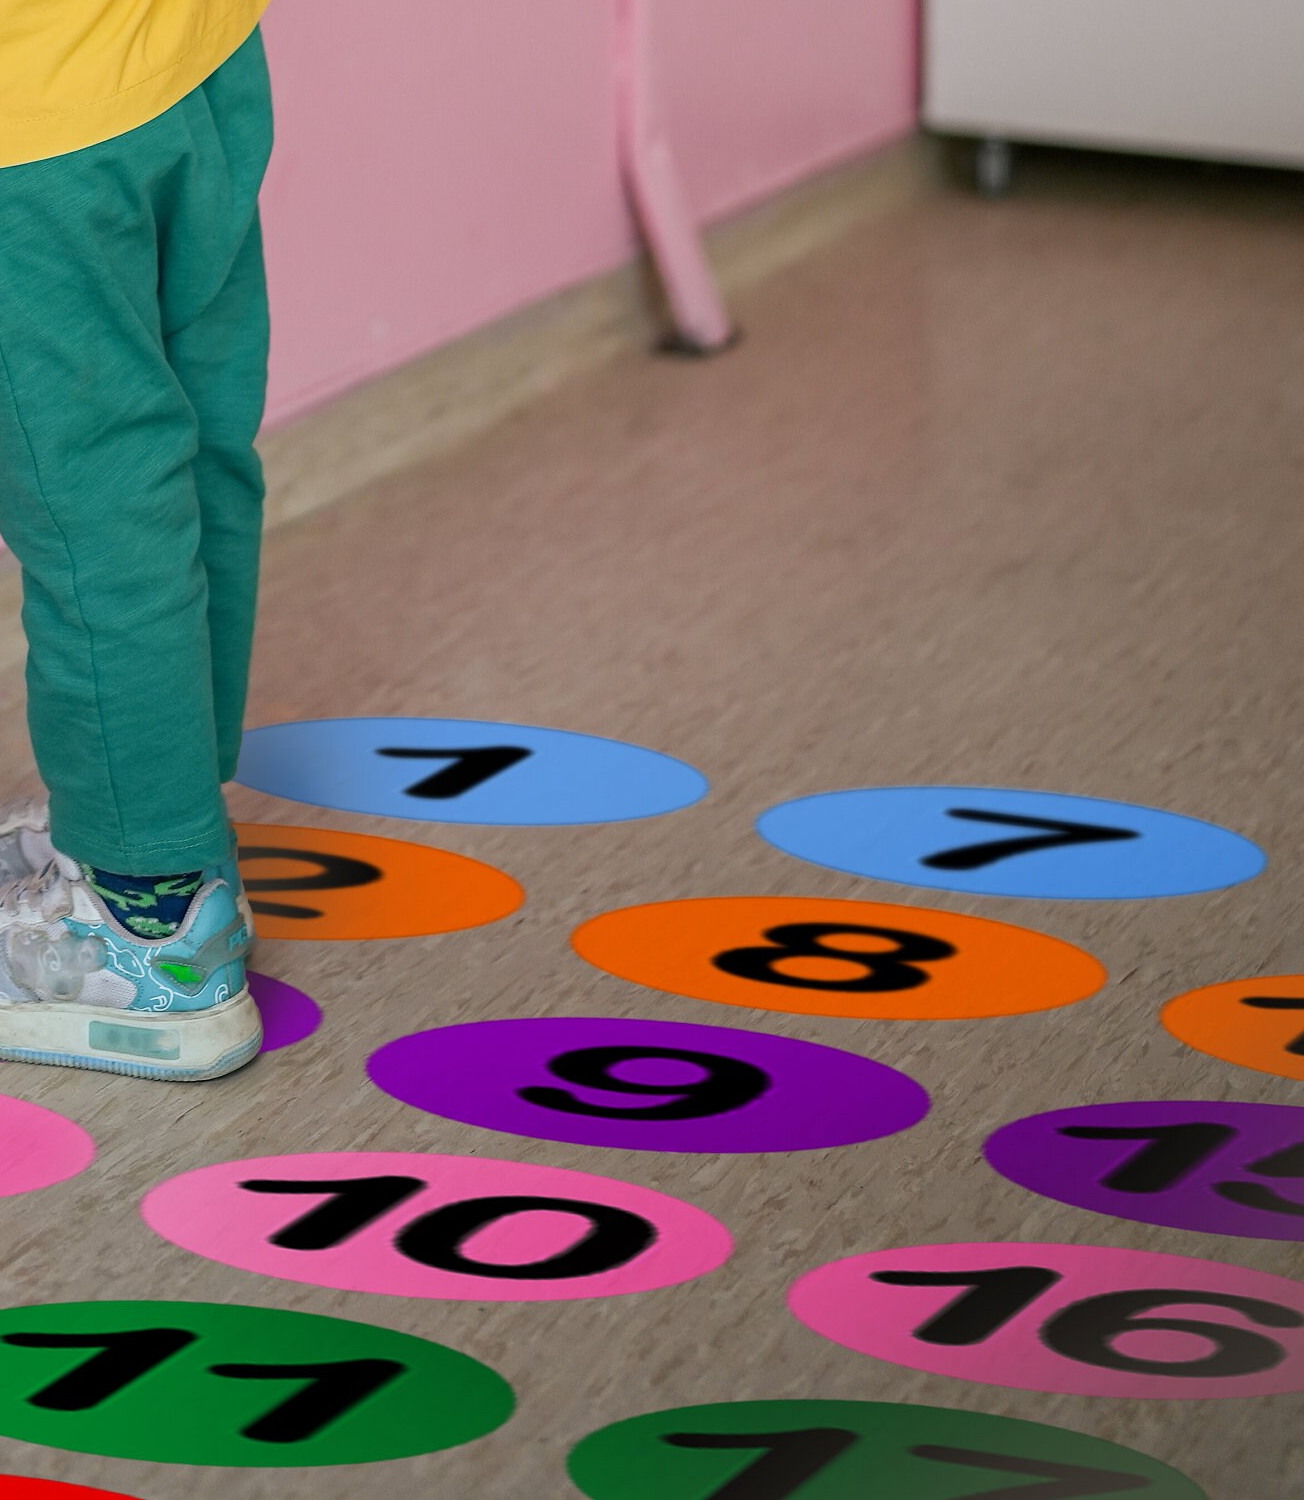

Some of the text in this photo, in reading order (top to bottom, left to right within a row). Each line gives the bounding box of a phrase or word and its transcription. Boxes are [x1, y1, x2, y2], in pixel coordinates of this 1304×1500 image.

[376, 744, 533, 800] 1
[920, 808, 1141, 870] 7
[710, 922, 958, 993] 8
[515, 1045, 773, 1122] 9
[239, 1175, 659, 1280] 10
[869, 1265, 1304, 1379] 16
[658, 1426, 1155, 1500] 17
